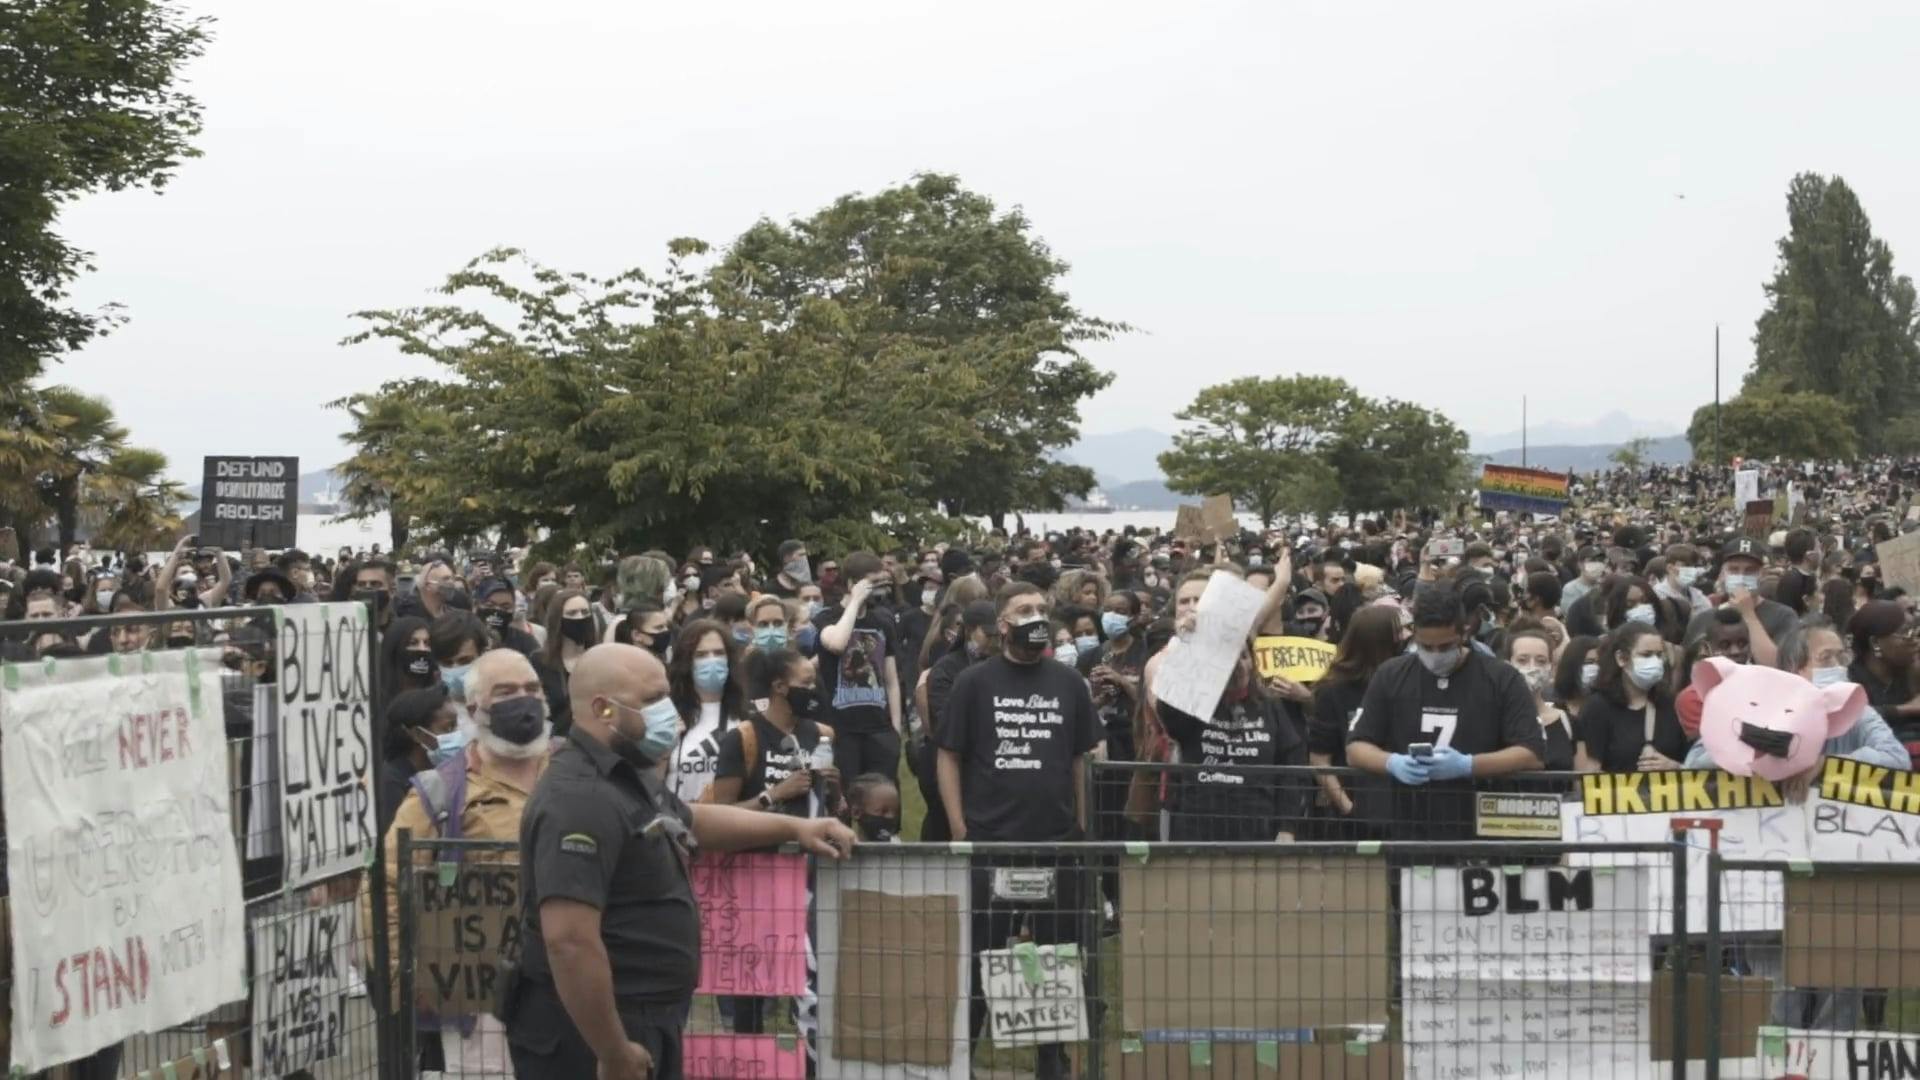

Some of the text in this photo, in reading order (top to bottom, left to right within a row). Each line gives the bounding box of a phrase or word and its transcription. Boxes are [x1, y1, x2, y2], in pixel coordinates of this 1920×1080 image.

[216, 461, 285, 477] DEFUND
[215, 481, 286, 499] DEMILITARIZE
[215, 503, 284, 520] ABOLISH
[1739, 539, 1752, 553] H
[282, 616, 369, 705] BLACK
[993, 696, 1025, 708] Love
[994, 711, 1064, 725] People Like
[1420, 712, 1458, 749] 7
[117, 706, 194, 770] NEVER
[995, 726, 1052, 739] You Love
[283, 702, 369, 796] LIVES
[1226, 744, 1259, 757] Love
[995, 757, 1043, 769] Culture
[286, 780, 373, 886] MATTER
[421, 869, 517, 913] RACIS
[1462, 868, 1594, 917] BLM
[453, 914, 486, 954] IS
[1443, 923, 1497, 944] CAN'T
[49, 934, 150, 1029] STAND
[419, 960, 497, 1000] VIR
[995, 1004, 1081, 1029] MATTER
